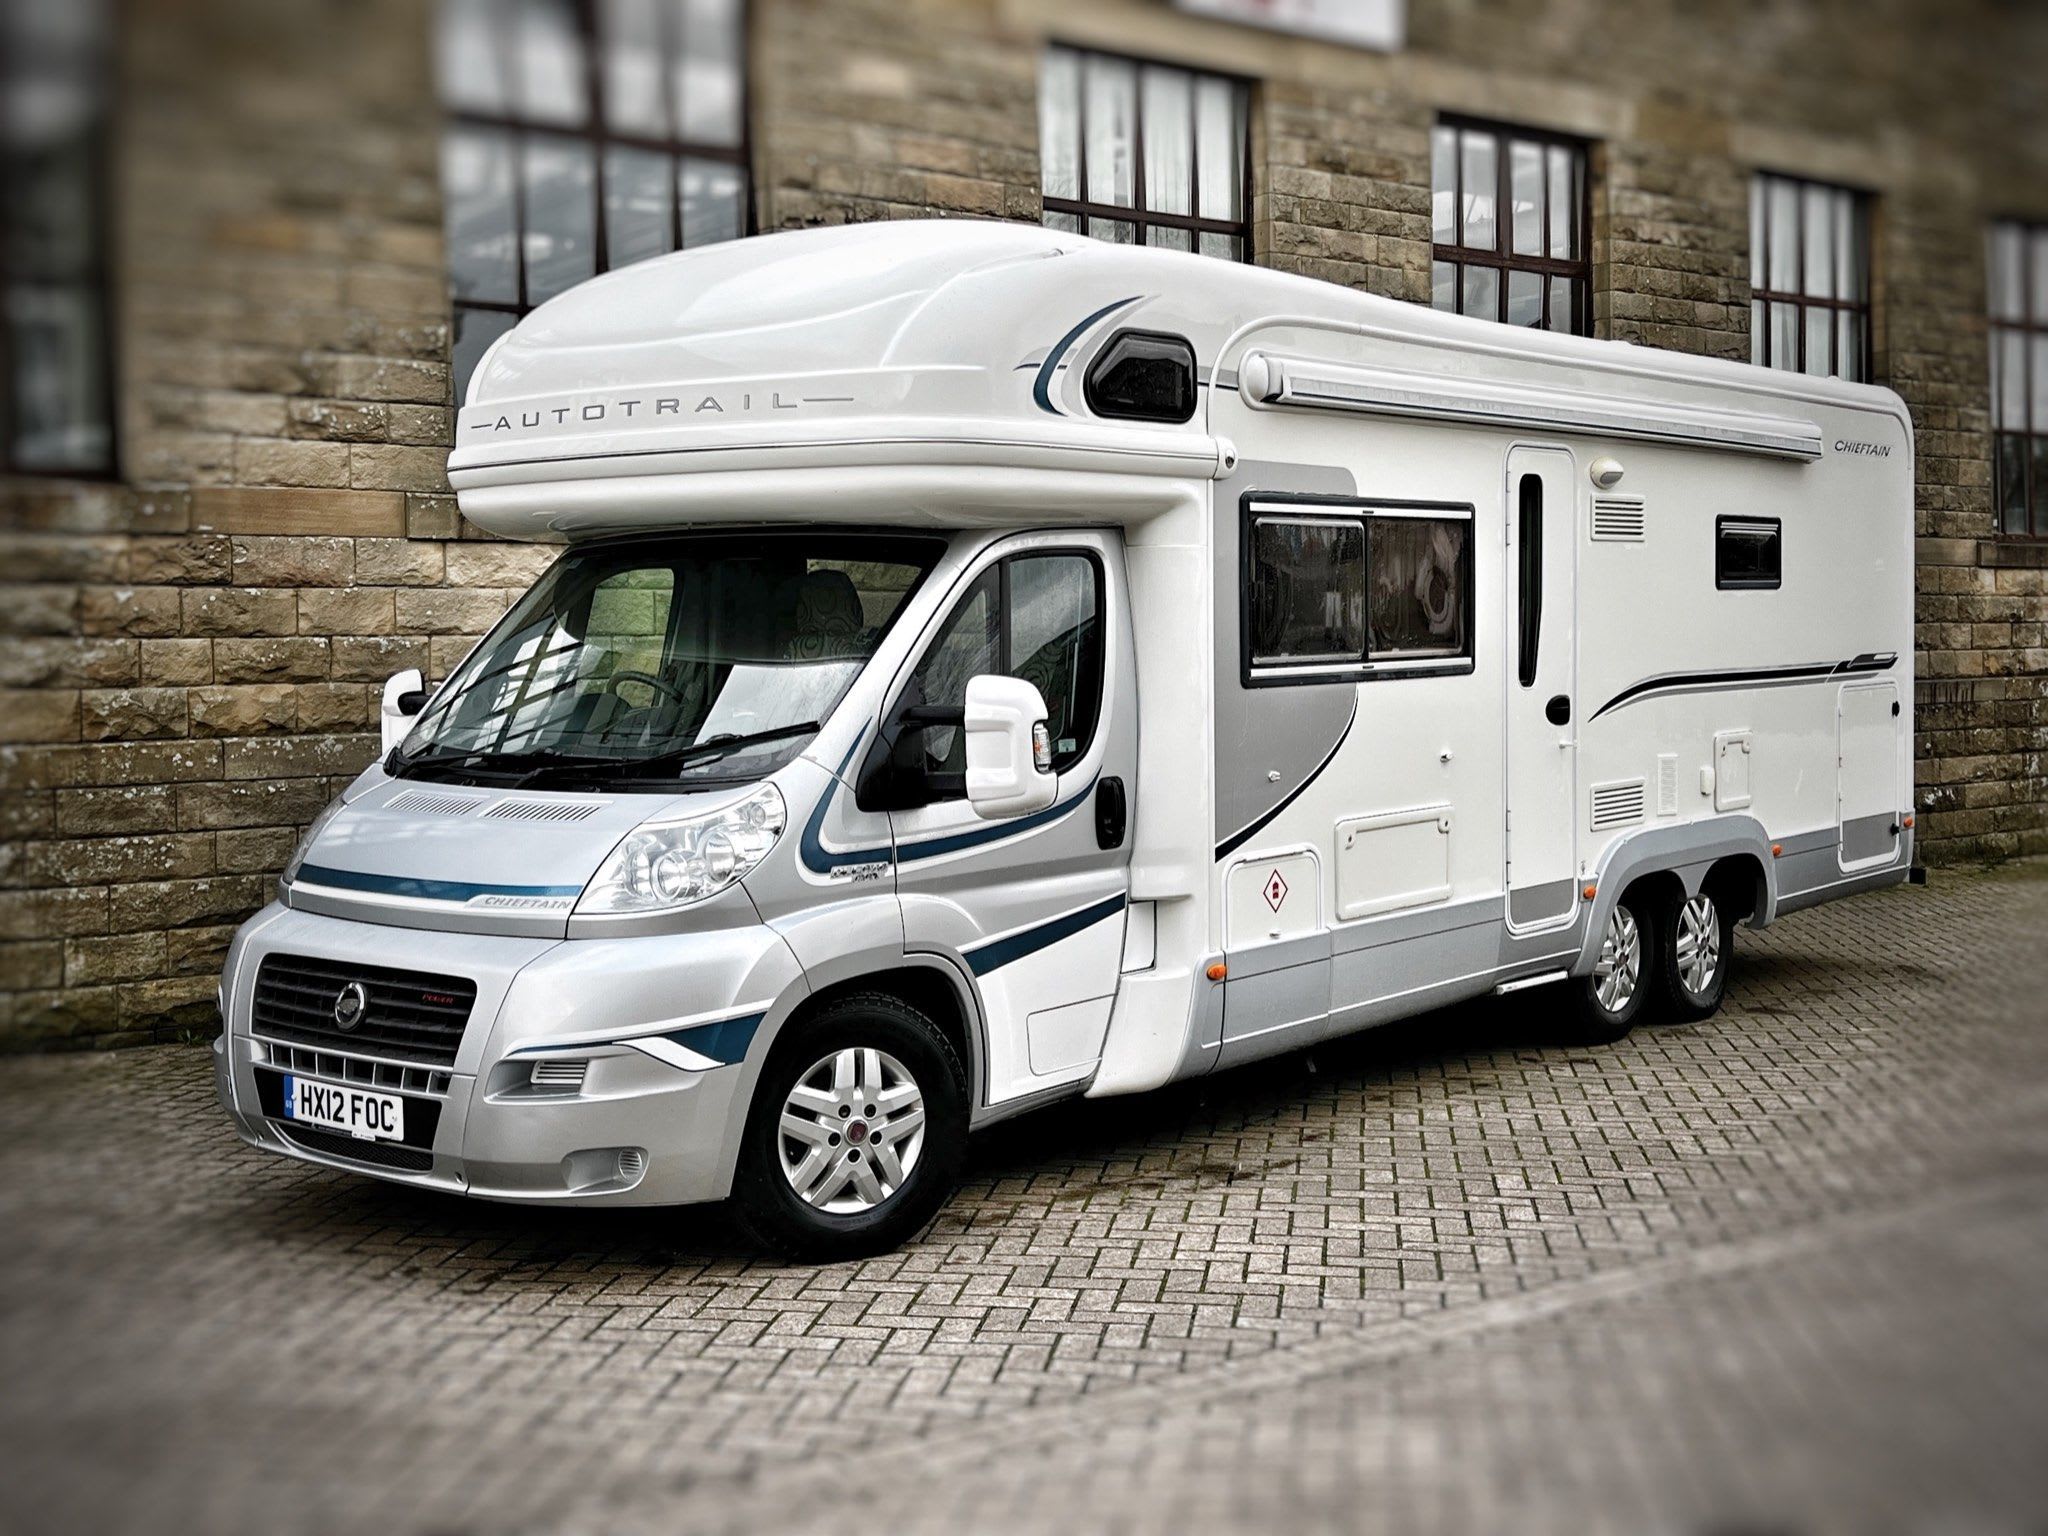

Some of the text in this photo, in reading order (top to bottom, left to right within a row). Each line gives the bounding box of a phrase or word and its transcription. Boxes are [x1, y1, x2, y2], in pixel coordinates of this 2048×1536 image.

[495, 393, 798, 431] AUTOTRAIL
[1834, 440, 1891, 457] CHIEFTAIN
[485, 896, 572, 909] CHIEFTAIN
[301, 1083, 394, 1132] HX12 FOC
